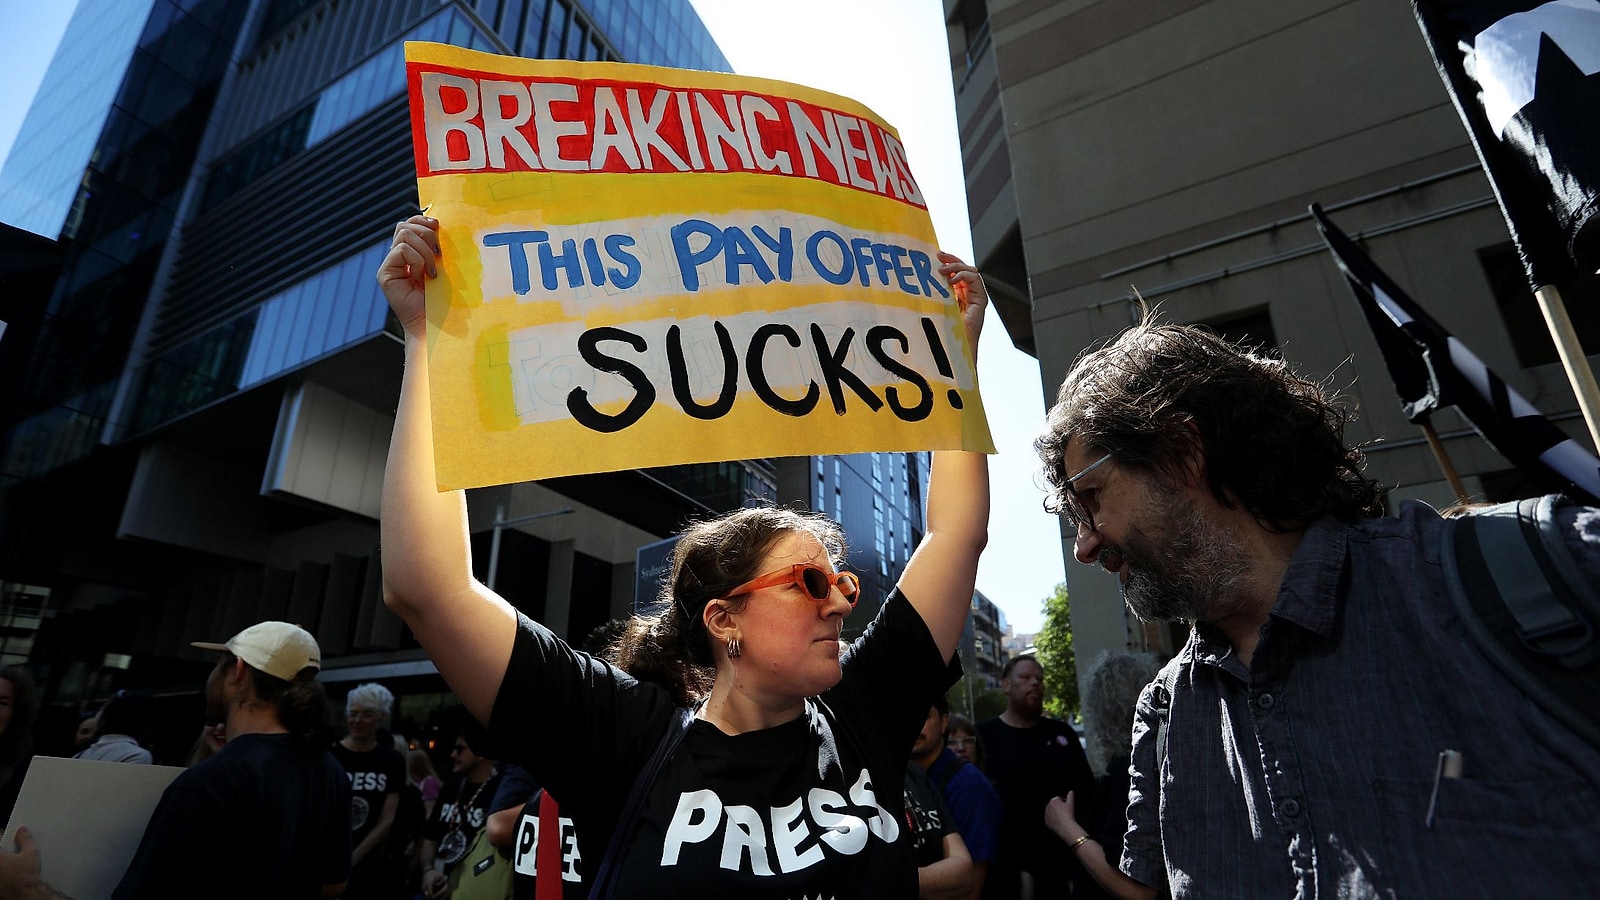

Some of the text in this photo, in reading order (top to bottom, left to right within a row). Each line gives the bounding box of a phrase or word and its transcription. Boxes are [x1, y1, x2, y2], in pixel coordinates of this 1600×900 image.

[419, 72, 925, 206] BREAKING NEWS
[483, 230, 642, 295] THIS
[670, 219, 794, 291] PAY
[805, 231, 949, 298] OFFER
[566, 317, 964, 432] SUCKS!
[660, 768, 899, 876] PRESS
